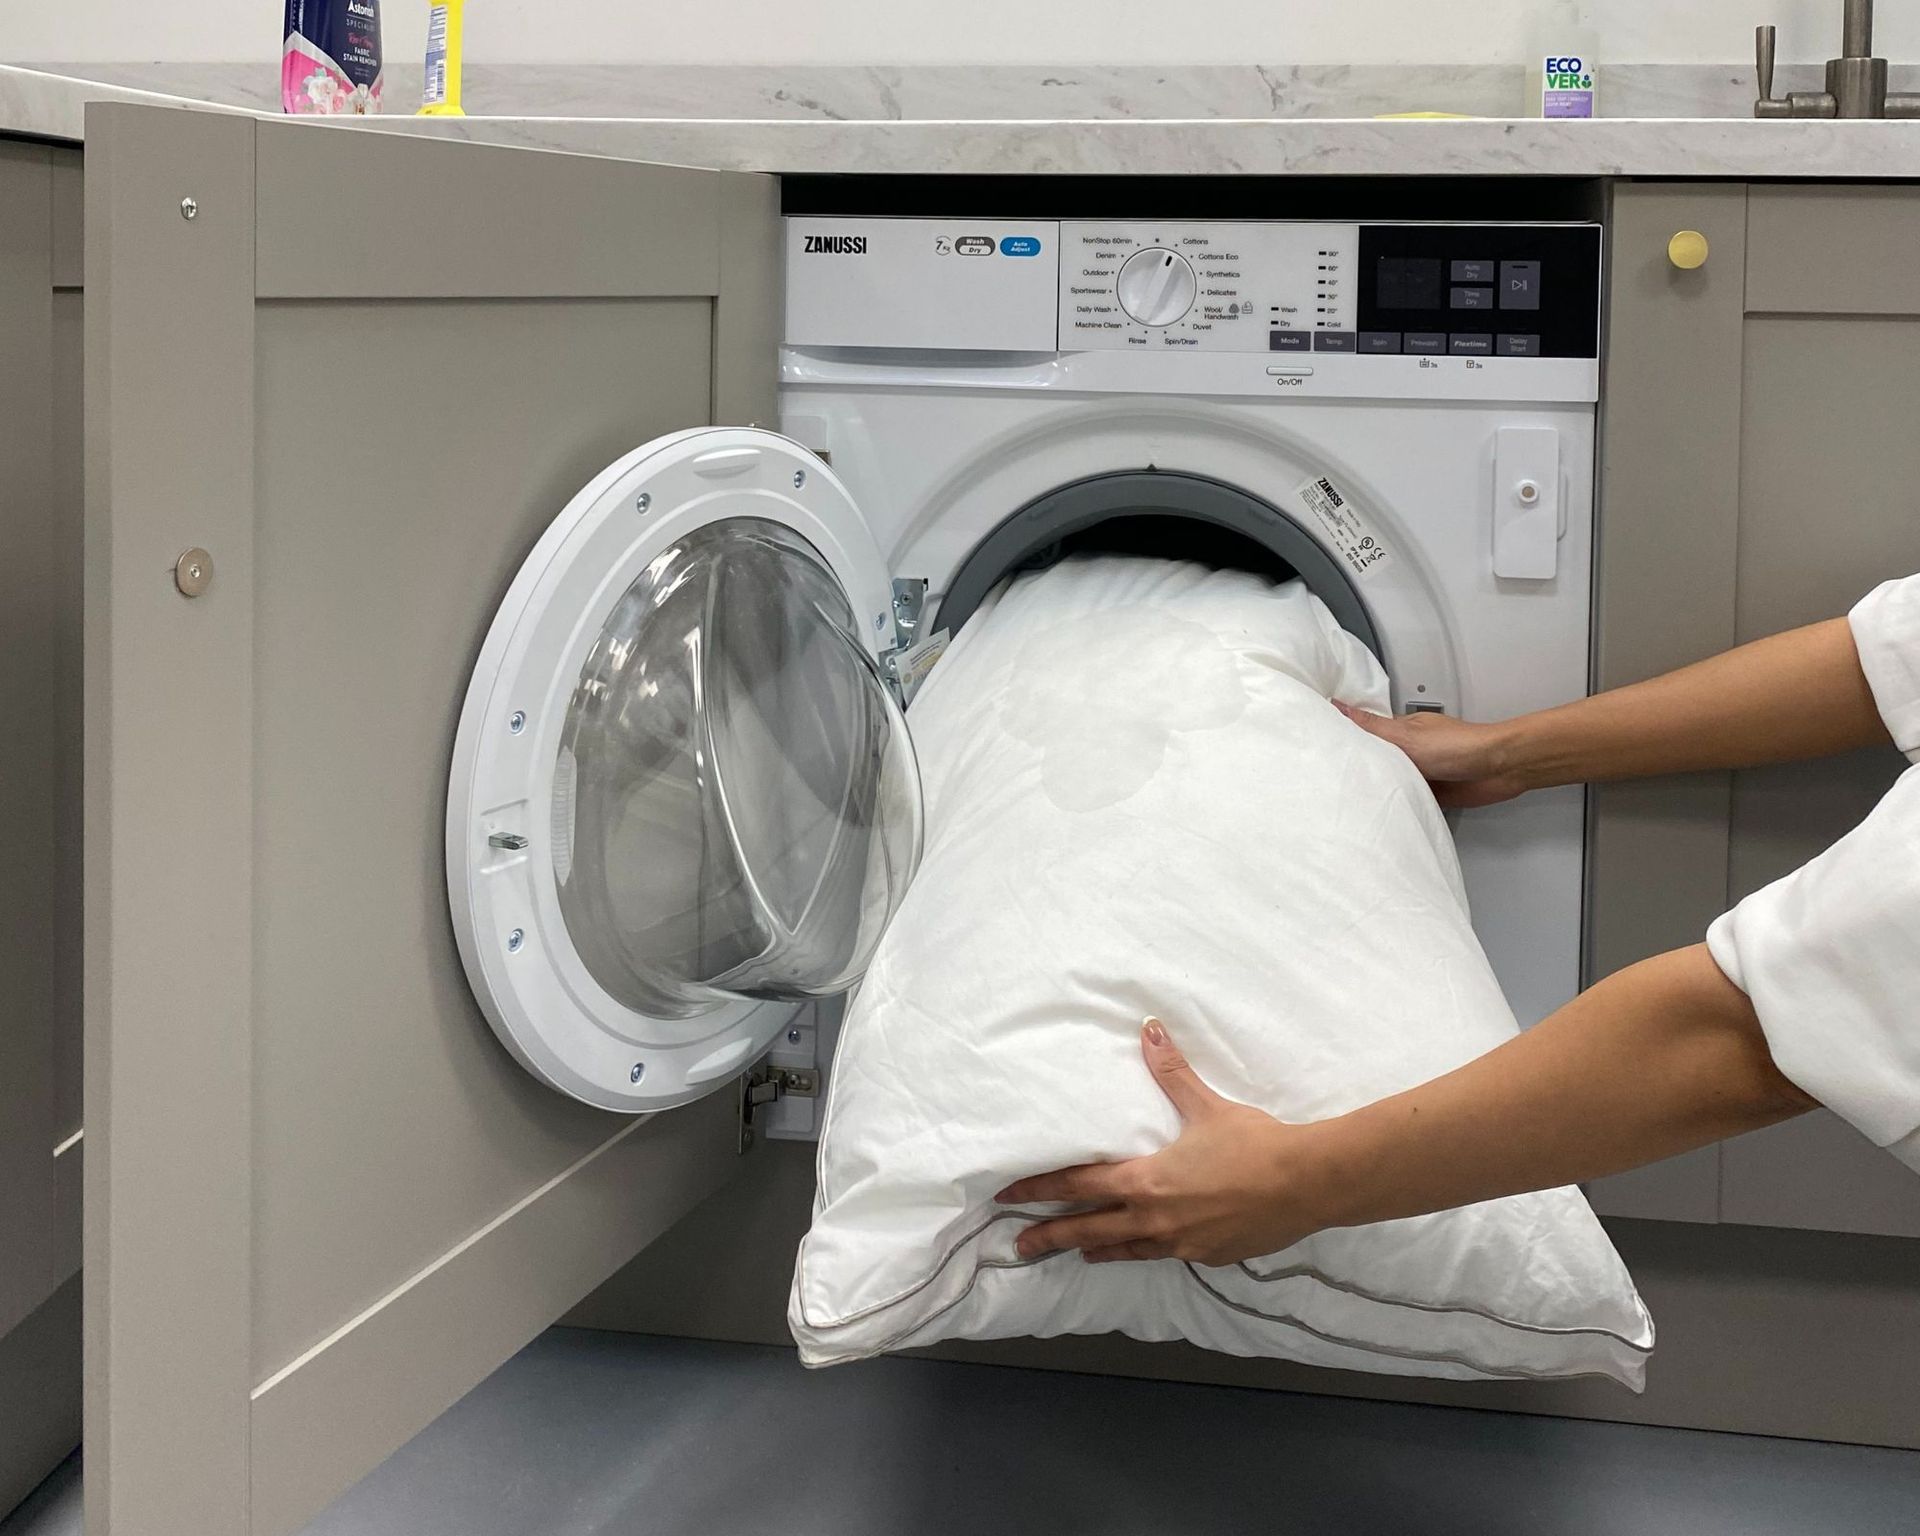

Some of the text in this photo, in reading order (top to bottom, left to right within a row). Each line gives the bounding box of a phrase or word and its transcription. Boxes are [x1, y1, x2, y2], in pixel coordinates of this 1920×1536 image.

[354, 47, 370, 57] FABRIC
[343, 53, 377, 67] STAIN REMOVER
[1546, 58, 1582, 73] ECO
[1546, 74, 1581, 89] VER
[804, 236, 867, 254] ZANUSSI
[936, 240, 943, 250] 7
[966, 238, 985, 246] Wash
[1082, 237, 1111, 245] NonStop
[968, 247, 982, 255] Dry
[1466, 271, 1480, 280] Dry
[1070, 287, 1107, 295] Sportswear
[1076, 306, 1092, 314] Daily
[1164, 338, 1198, 346] Spin/Drain
[1326, 338, 1343, 346] Temp
[1509, 337, 1528, 345] Delay
[1277, 378, 1303, 386] On/Off
[1318, 477, 1343, 507] ZANUSSI
[1374, 547, 1386, 559] CE
